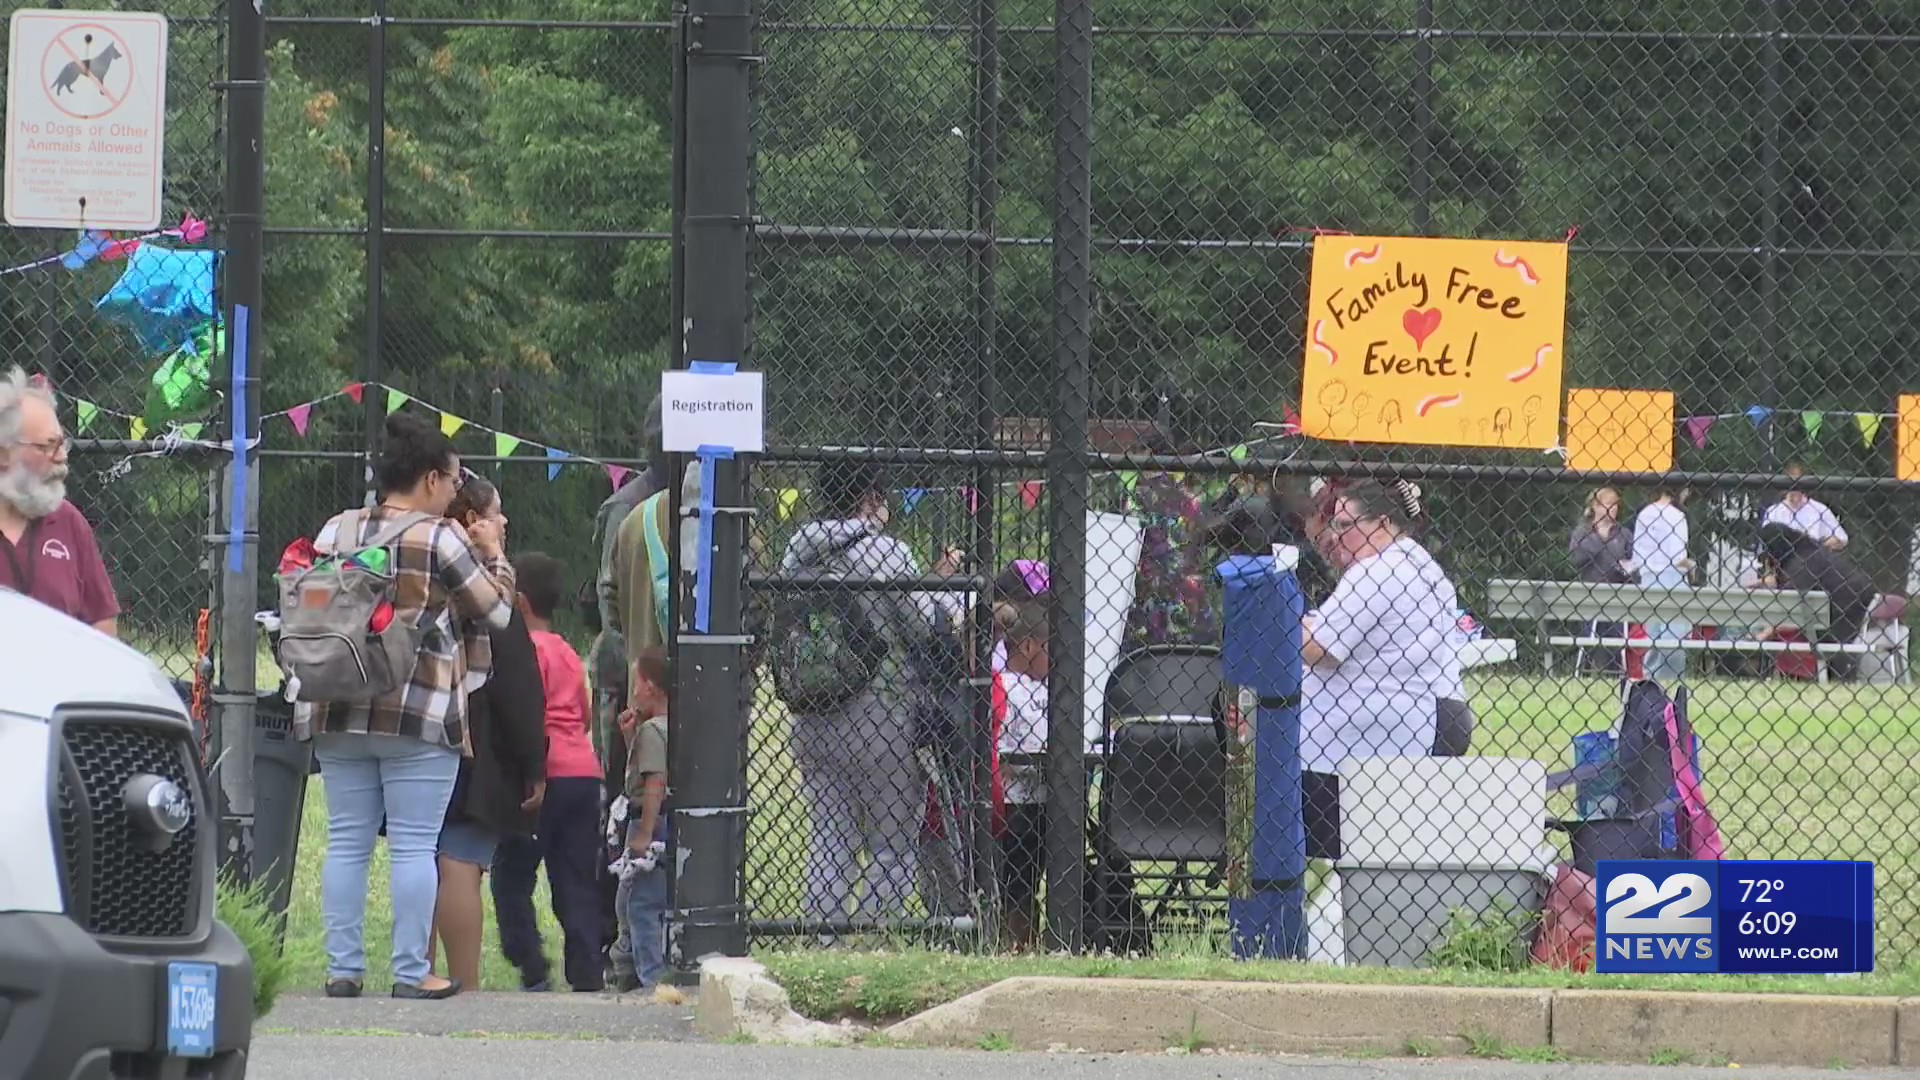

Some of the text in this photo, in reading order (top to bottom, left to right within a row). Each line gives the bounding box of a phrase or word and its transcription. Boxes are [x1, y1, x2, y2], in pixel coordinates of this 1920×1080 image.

[20, 121, 150, 138] No Dogs or Other
[26, 138, 143, 154] Animals Allowed
[1326, 261, 1526, 330] Family Free
[1363, 331, 1478, 378] Event!
[671, 399, 754, 414] Registration
